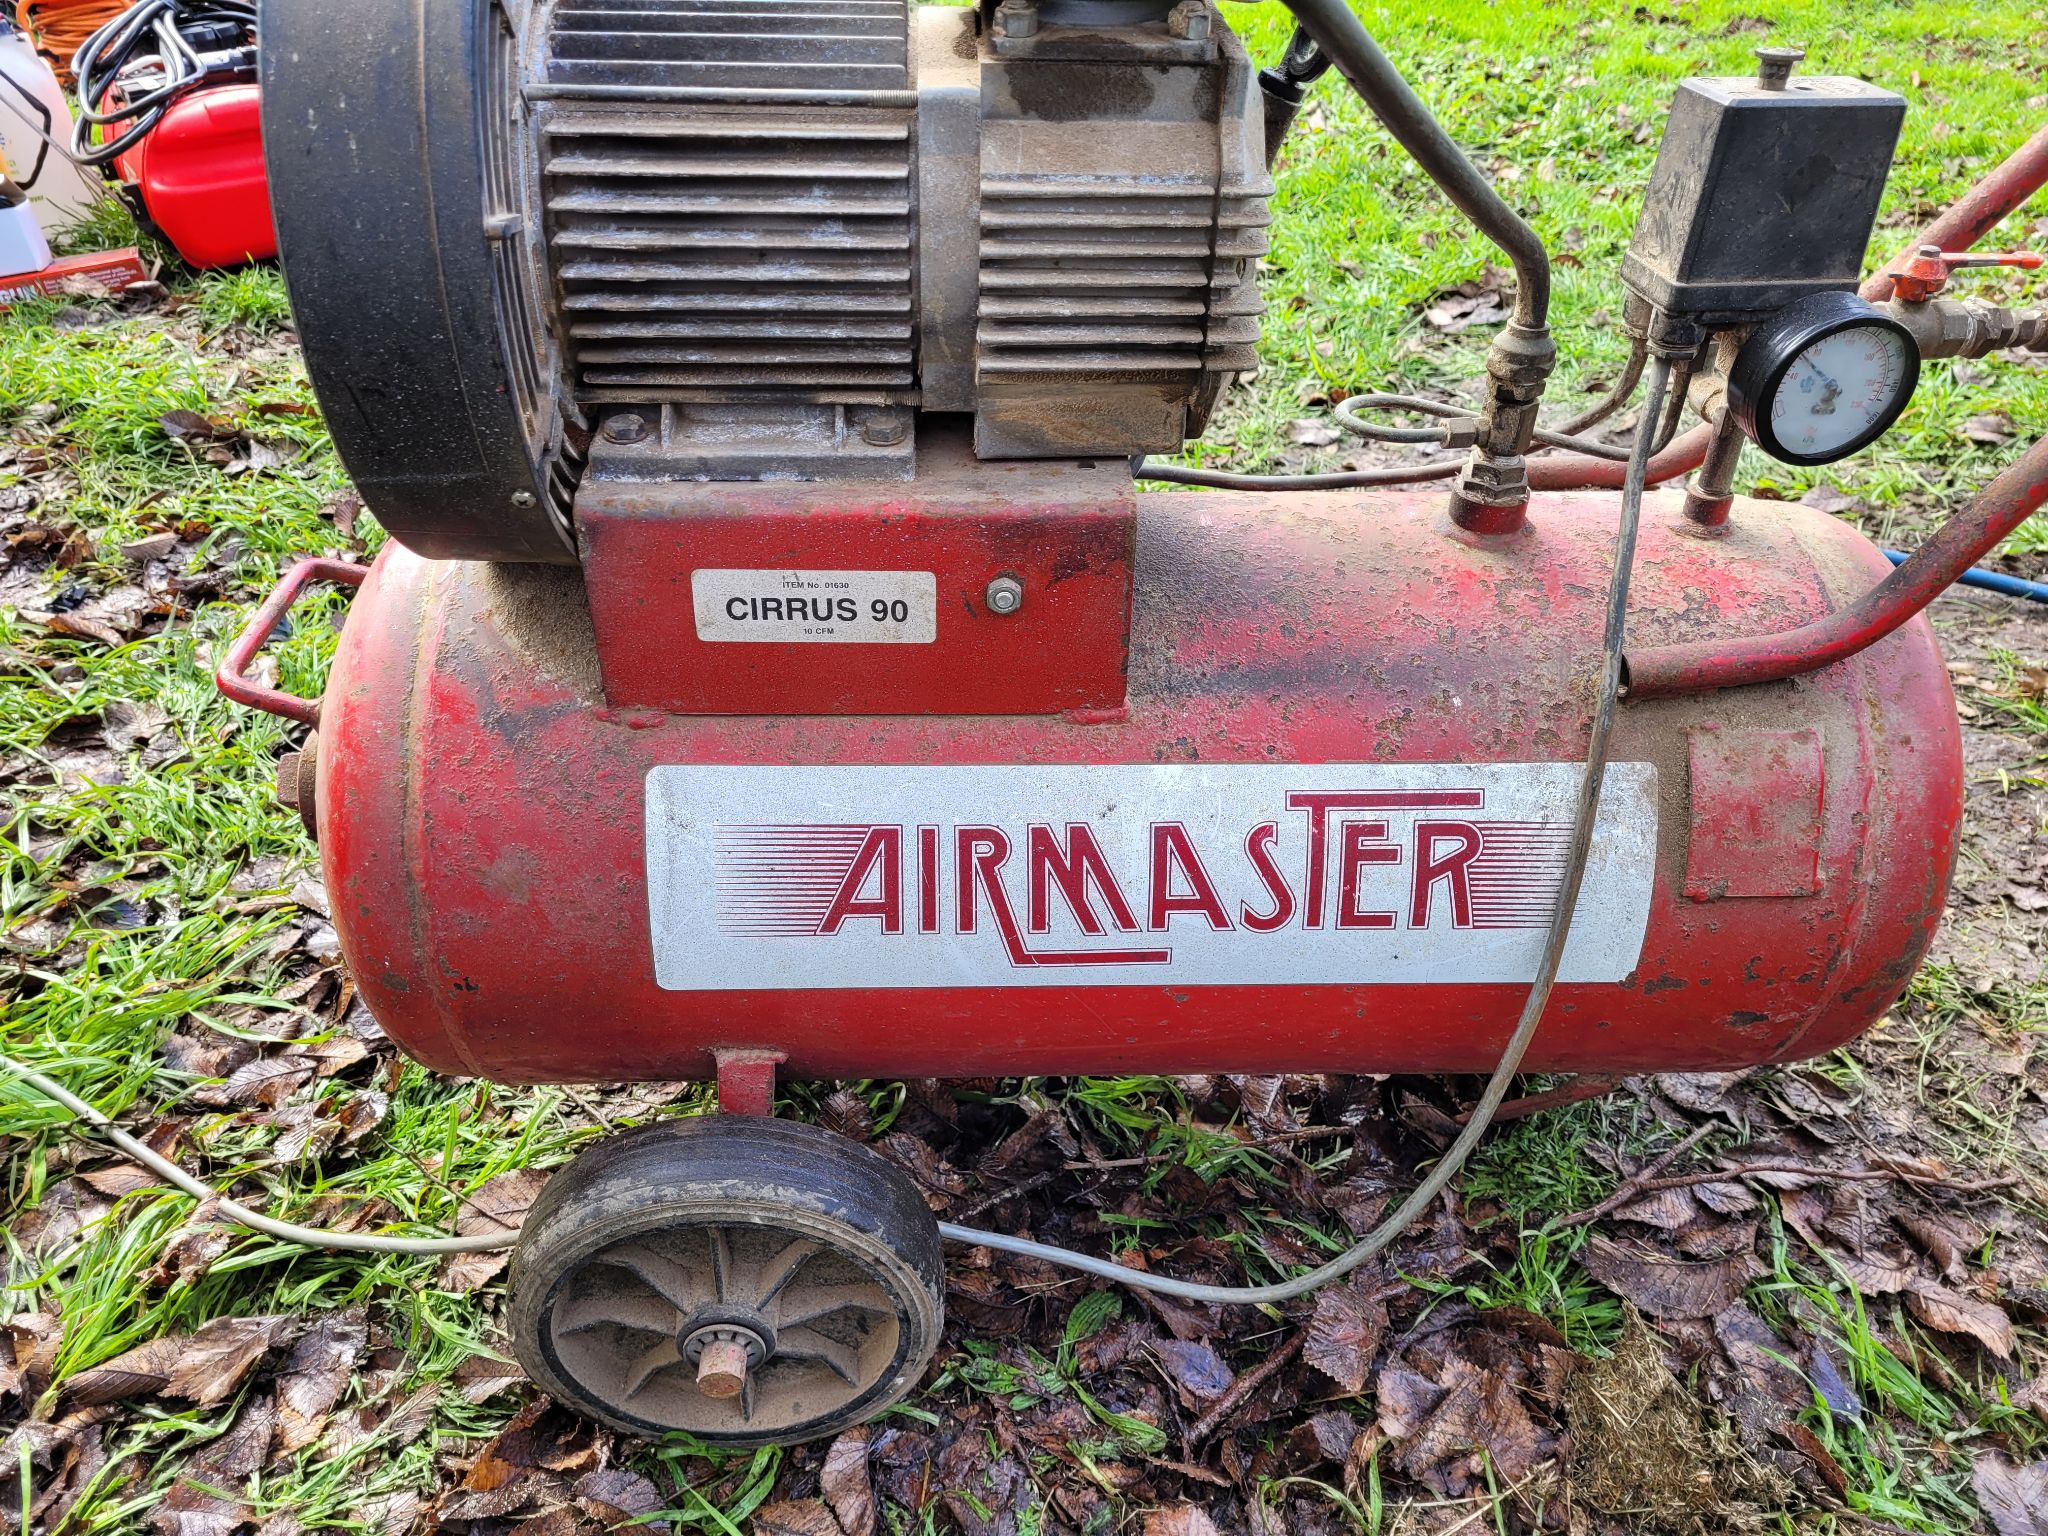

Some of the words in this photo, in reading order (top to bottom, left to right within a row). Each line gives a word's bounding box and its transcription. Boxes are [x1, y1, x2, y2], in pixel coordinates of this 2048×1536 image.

[782, 581, 804, 589] ITEM
[725, 597, 858, 622] CIRRUS
[870, 599, 909, 623] 90
[816, 788, 1486, 967] AIRMASTER
